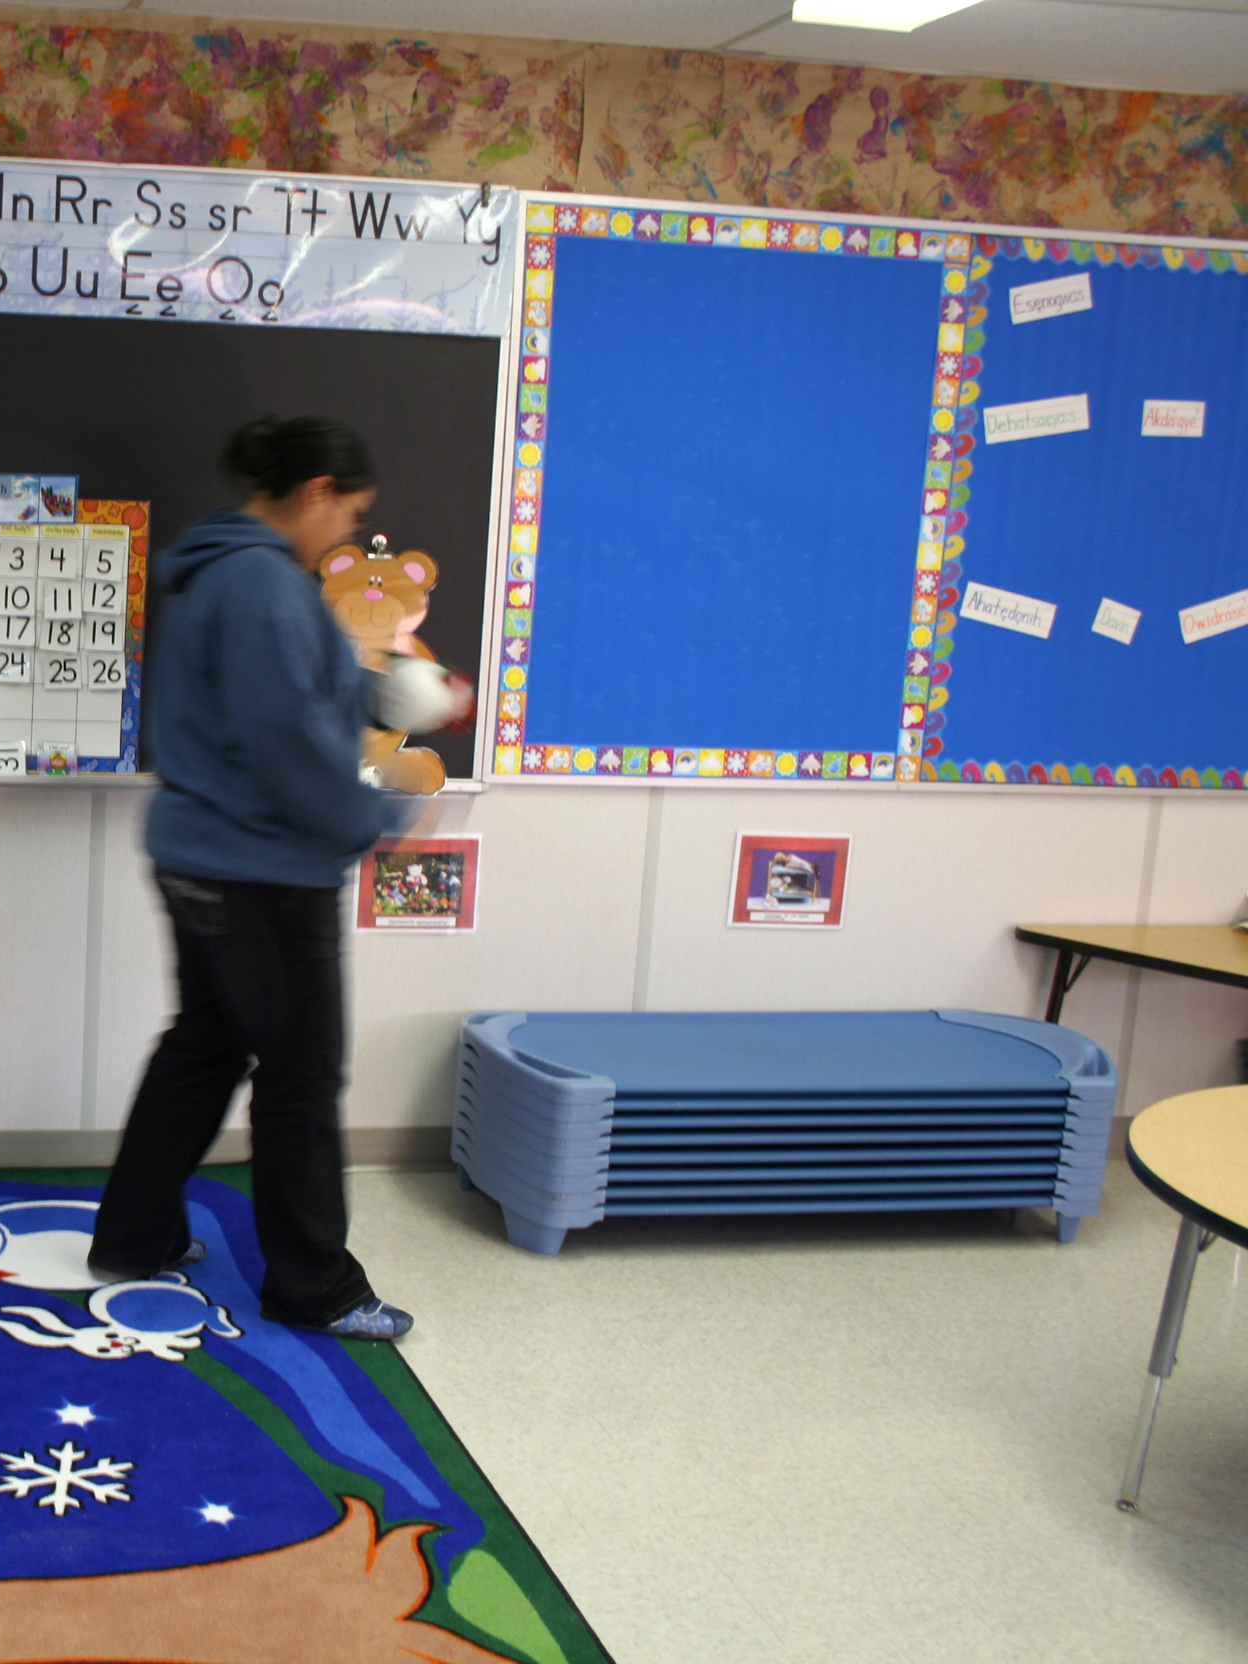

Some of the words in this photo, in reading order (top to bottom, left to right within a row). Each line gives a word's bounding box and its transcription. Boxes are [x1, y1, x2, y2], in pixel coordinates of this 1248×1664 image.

[53, 175, 111, 224] Rr
[133, 179, 186, 229] Ss
[206, 203, 251, 232] sr
[272, 187, 326, 237] Tt
[347, 190, 431, 241] Ww
[454, 197, 501, 266] Yy
[30, 246, 98, 298] Uu
[9, 546, 25, 571] 3
[50, 547, 66, 572] 4
[96, 549, 114, 574] 5
[4, 585, 30, 610] 10
[53, 588, 72, 612] 11
[91, 582, 116, 608] 12
[6, 615, 31, 640] 17
[48, 619, 75, 646] 18
[91, 620, 116, 645] 19
[49, 658, 78, 684] 25
[92, 659, 122, 684] 26
